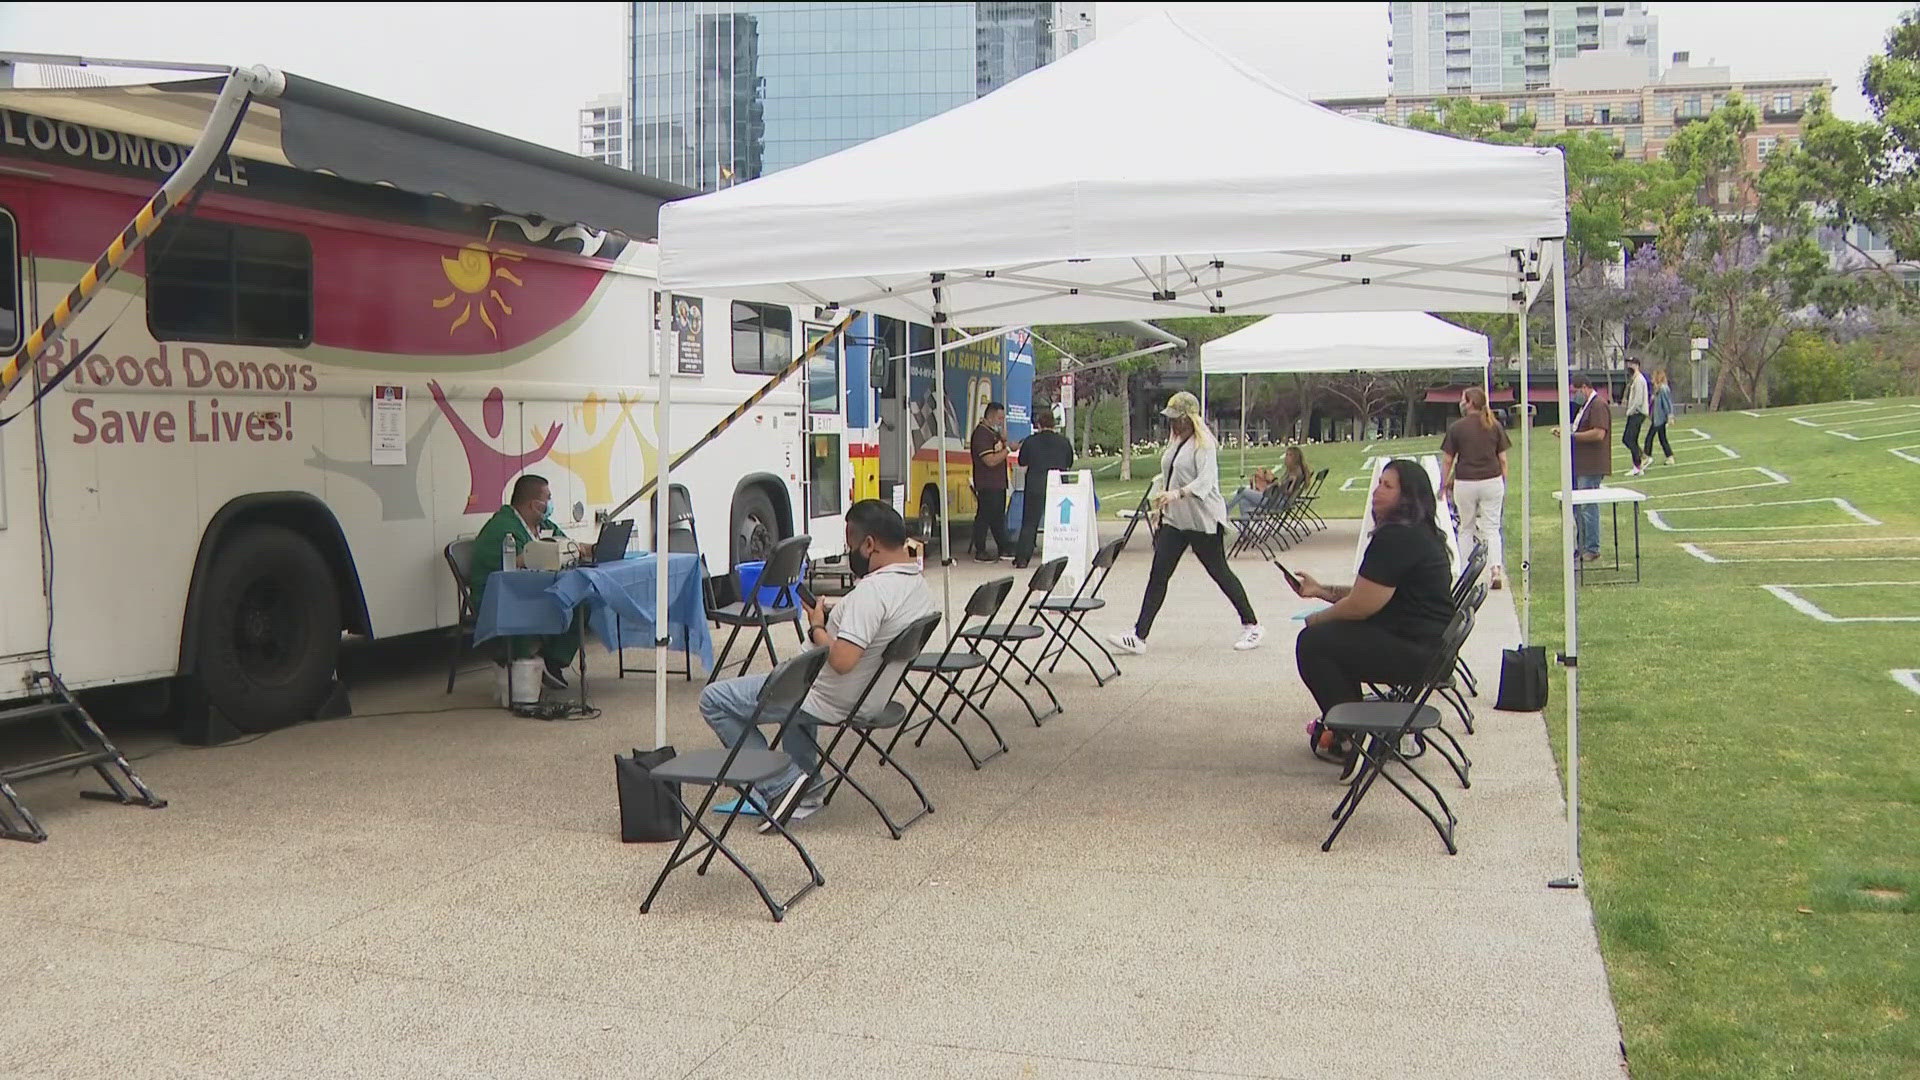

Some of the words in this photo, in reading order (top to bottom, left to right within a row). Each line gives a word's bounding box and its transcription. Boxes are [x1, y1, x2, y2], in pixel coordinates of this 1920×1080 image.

[0, 110, 248, 186] LOODMOLE
[39, 337, 172, 388] Blood
[183, 347, 318, 392] Donors
[958, 351, 980, 371] SAVE
[71, 398, 176, 445] Save
[188, 398, 293, 443] Lives!
[818, 417, 832, 430] EXIT
[785, 451, 791, 468] 5
